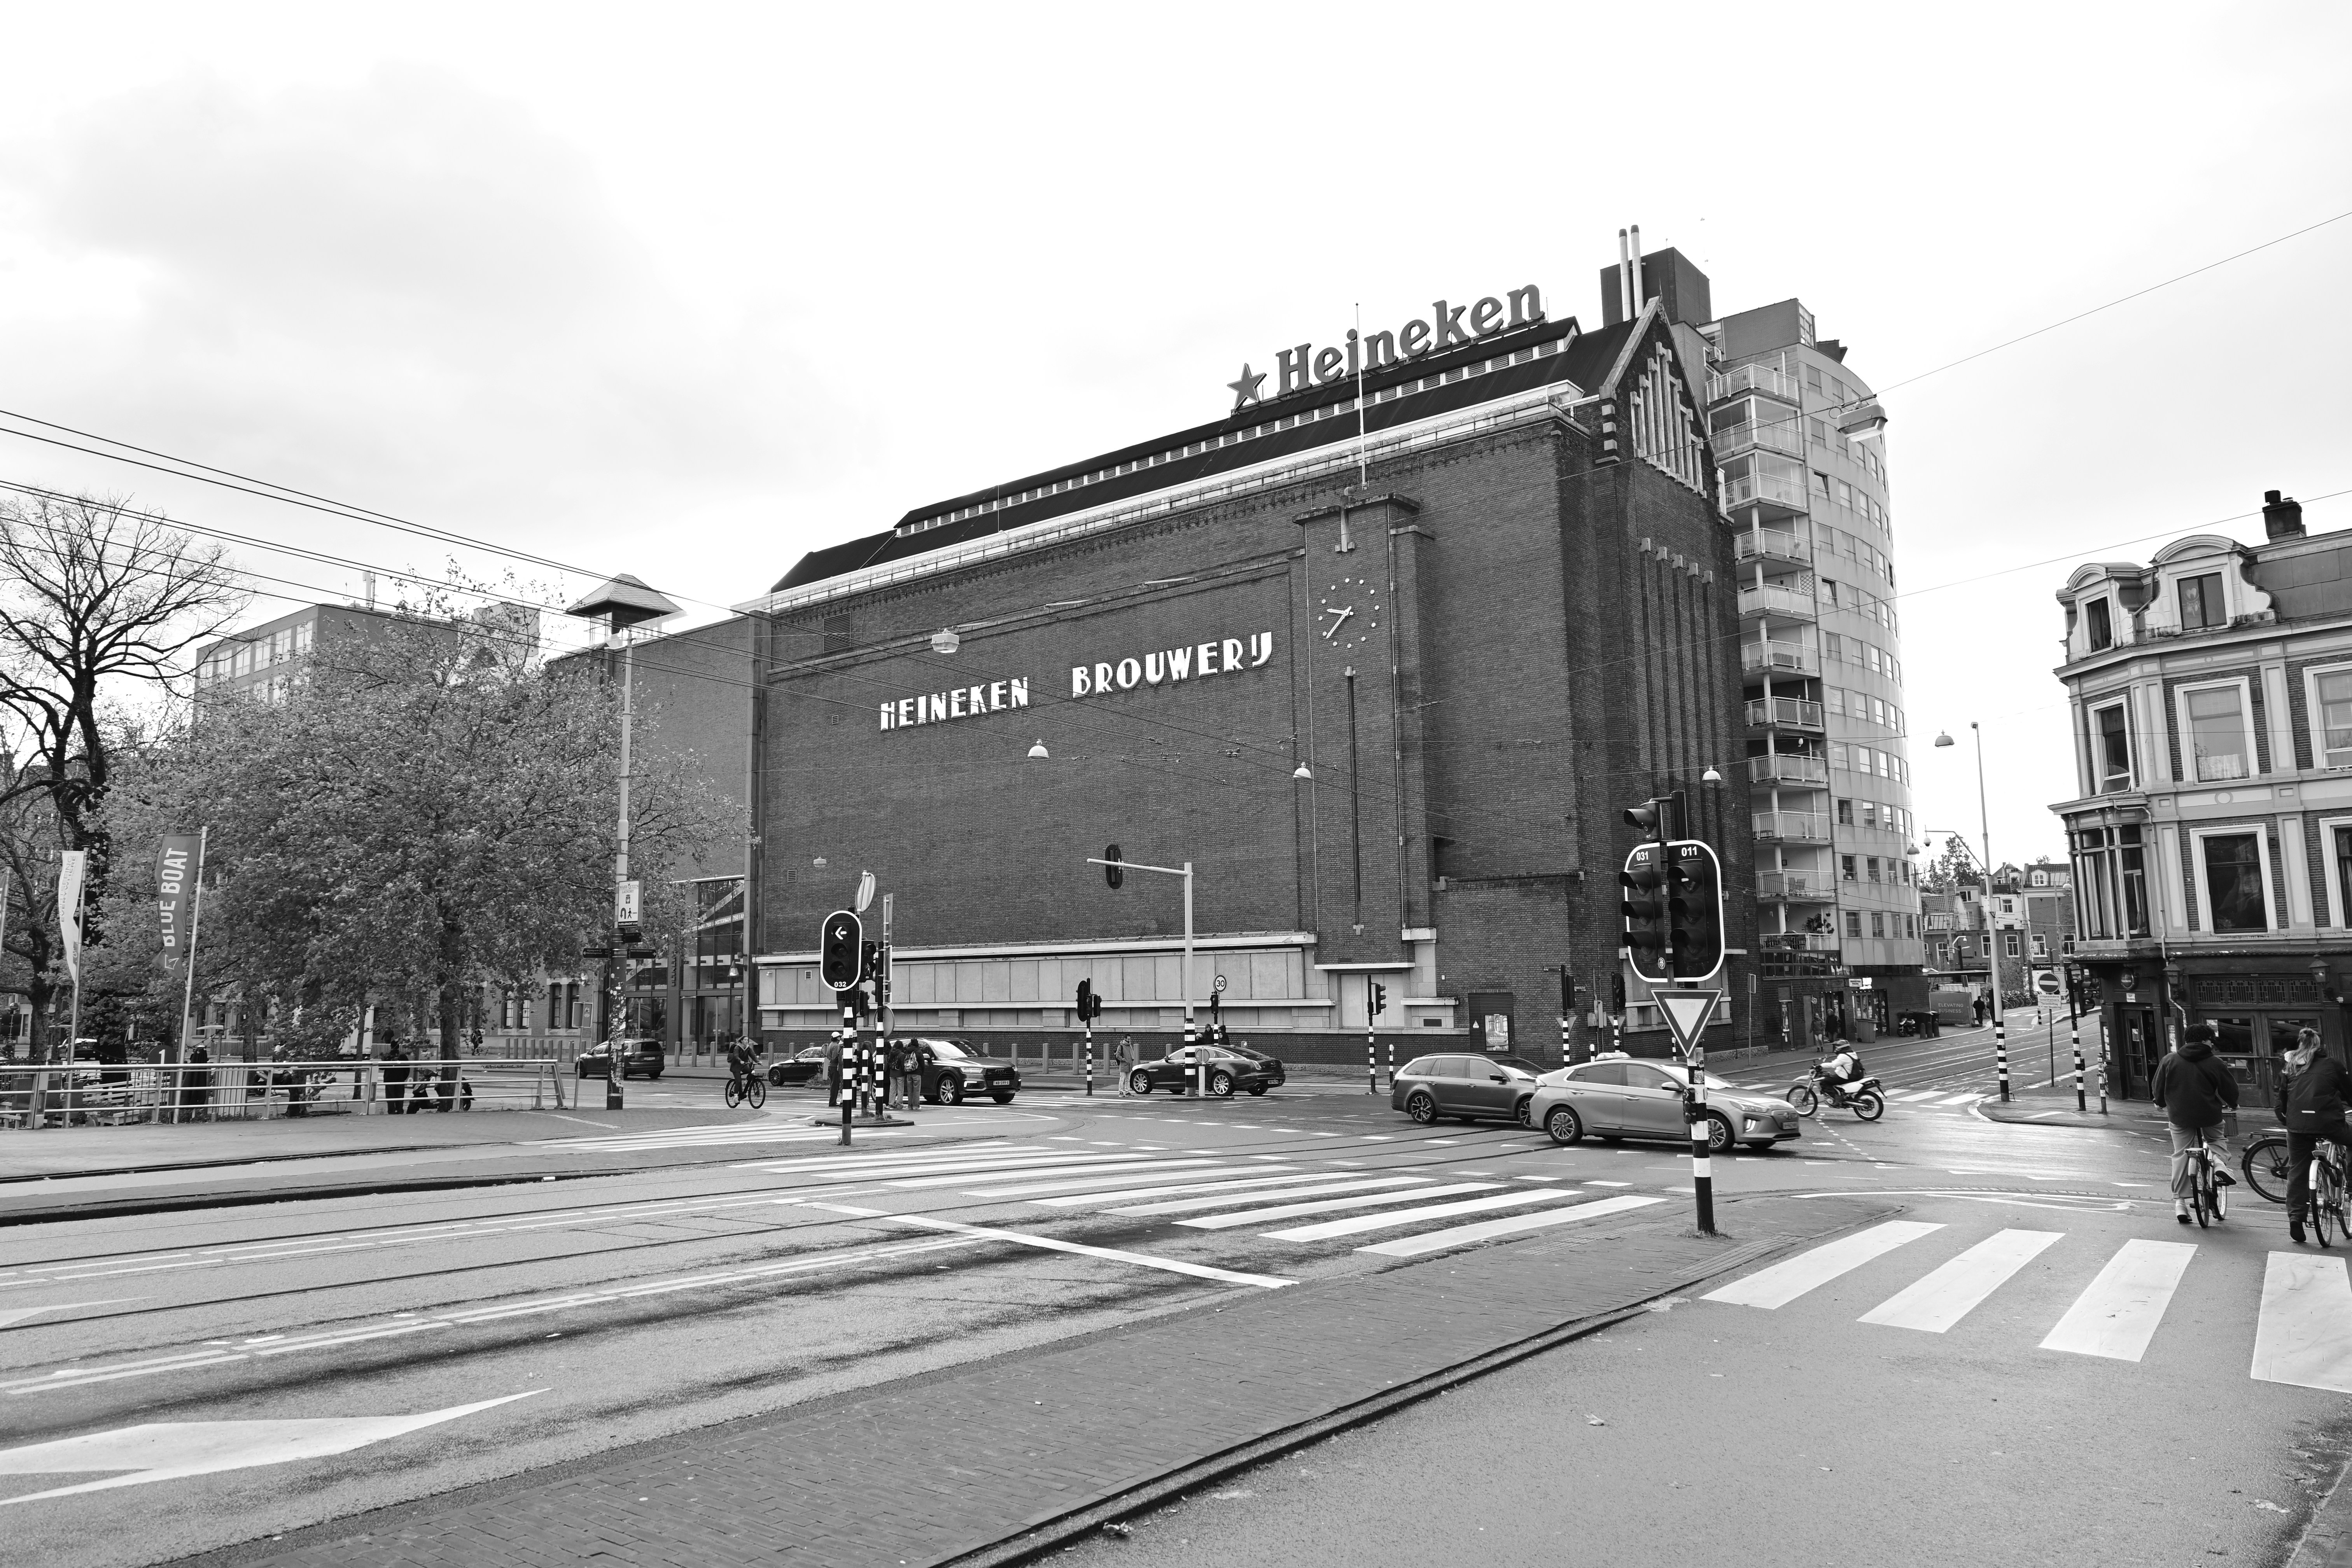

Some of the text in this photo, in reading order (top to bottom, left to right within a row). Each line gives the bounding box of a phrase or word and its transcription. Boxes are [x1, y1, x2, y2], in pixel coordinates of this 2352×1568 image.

[1276, 284, 1545, 397] Heineken
[880, 631, 1272, 732] HEINEKEN BROUWERIJ
[1636, 851, 1648, 861] 031
[1681, 846, 1698, 857] 011
[161, 848, 188, 894] BOAT
[159, 1049, 165, 1064] 1
